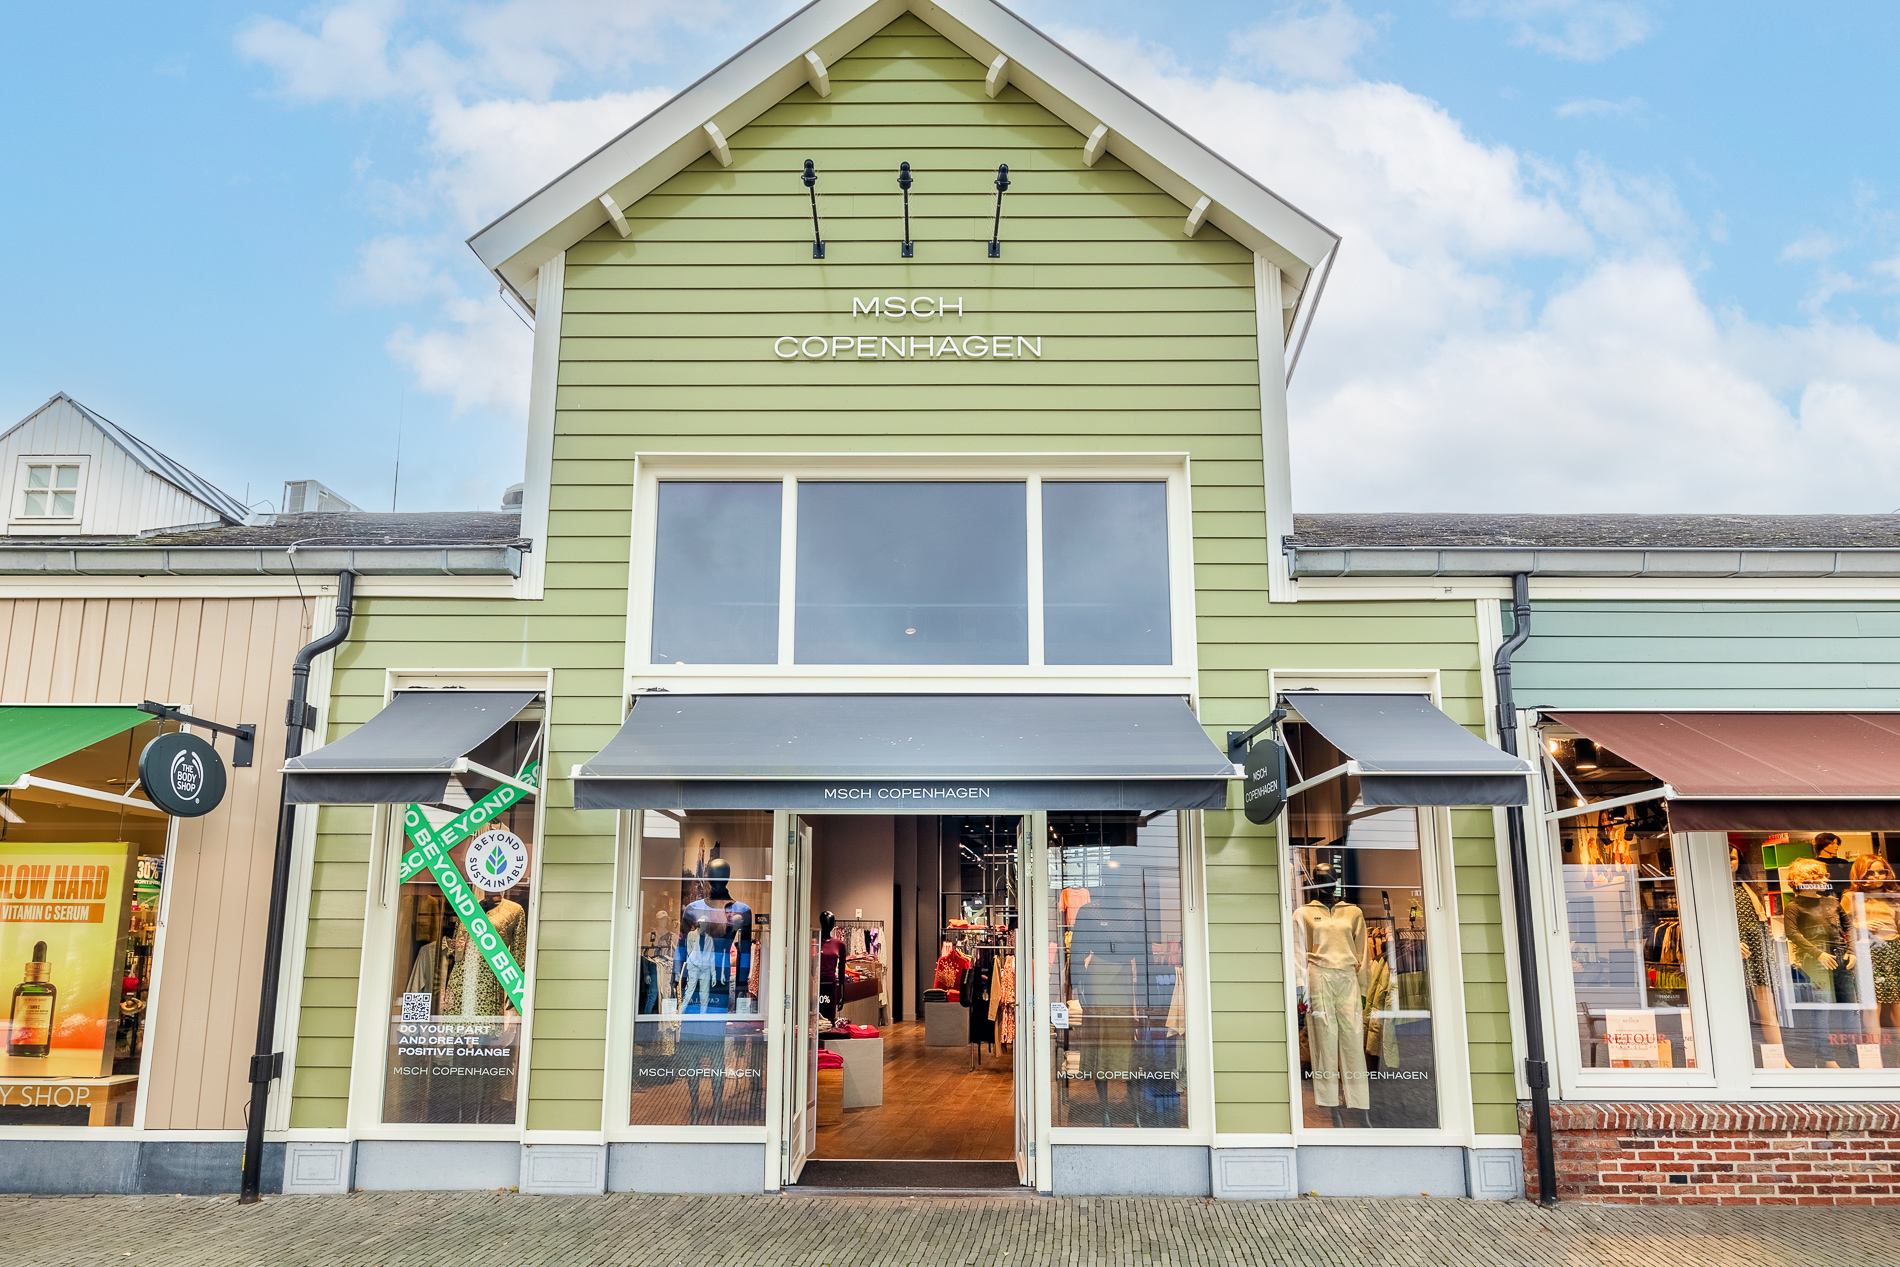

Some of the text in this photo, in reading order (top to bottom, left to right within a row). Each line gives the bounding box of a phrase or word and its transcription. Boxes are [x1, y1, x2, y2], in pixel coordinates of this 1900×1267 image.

[852, 296, 963, 318] MSCH
[774, 336, 1042, 358] COPENHAGEN
[182, 763, 194, 773] THE
[1252, 766, 1268, 782] MSCH
[177, 770, 197, 783] BODY
[176, 780, 196, 792] SHOP
[1245, 779, 1278, 803] COPENHAGEN
[824, 787, 990, 799] MSCH COPENHAGEN
[437, 787, 515, 848] EYOND
[473, 833, 520, 852] BEYOND
[136, 860, 159, 879] 30%
[469, 855, 524, 888] SUSTAINABLE
[52, 865, 110, 900] HARD
[2, 905, 90, 921] VITAMIN C SERUM
[414, 828, 476, 917] BEYOND
[471, 918, 497, 951] GO
[491, 951, 525, 1009] BEY
[400, 1025, 491, 1034] DO YOUR PART
[399, 1036, 480, 1045] AND CREATE
[1603, 1033, 1667, 1045] RETOUR
[1828, 1033, 1893, 1046] RETOUR
[398, 1048, 511, 1057] POSITIVE CHANGE
[393, 1067, 515, 1076] MSCH COPENHAGEN
[639, 1068, 761, 1077] MSCH COPENHAGEN
[1056, 1071, 1180, 1080] MSCH COPENHAGEN
[1305, 1071, 1428, 1080] MSCH COPENHAGEN
[20, 1086, 91, 1108] SHOP.
